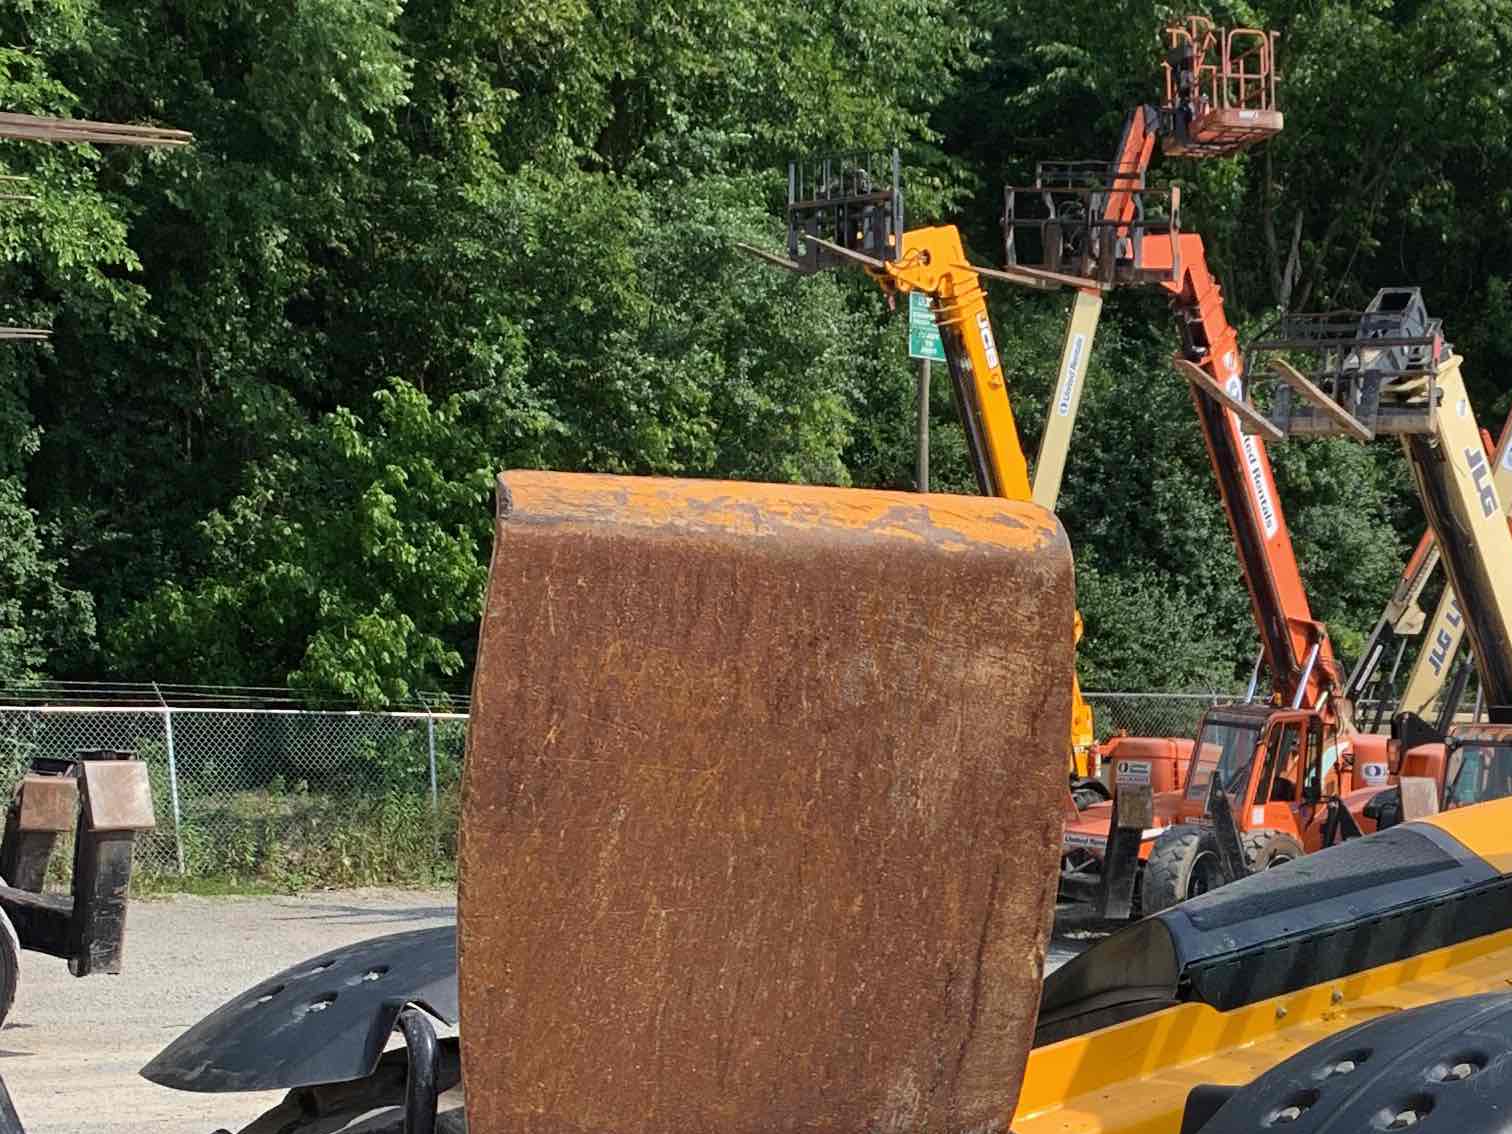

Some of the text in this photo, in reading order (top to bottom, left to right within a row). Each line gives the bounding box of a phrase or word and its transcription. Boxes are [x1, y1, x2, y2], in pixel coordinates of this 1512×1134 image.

[1243, 436, 1273, 529] ted Rentals
[1464, 447, 1499, 519] JLG
[1428, 629, 1453, 677] JLG
